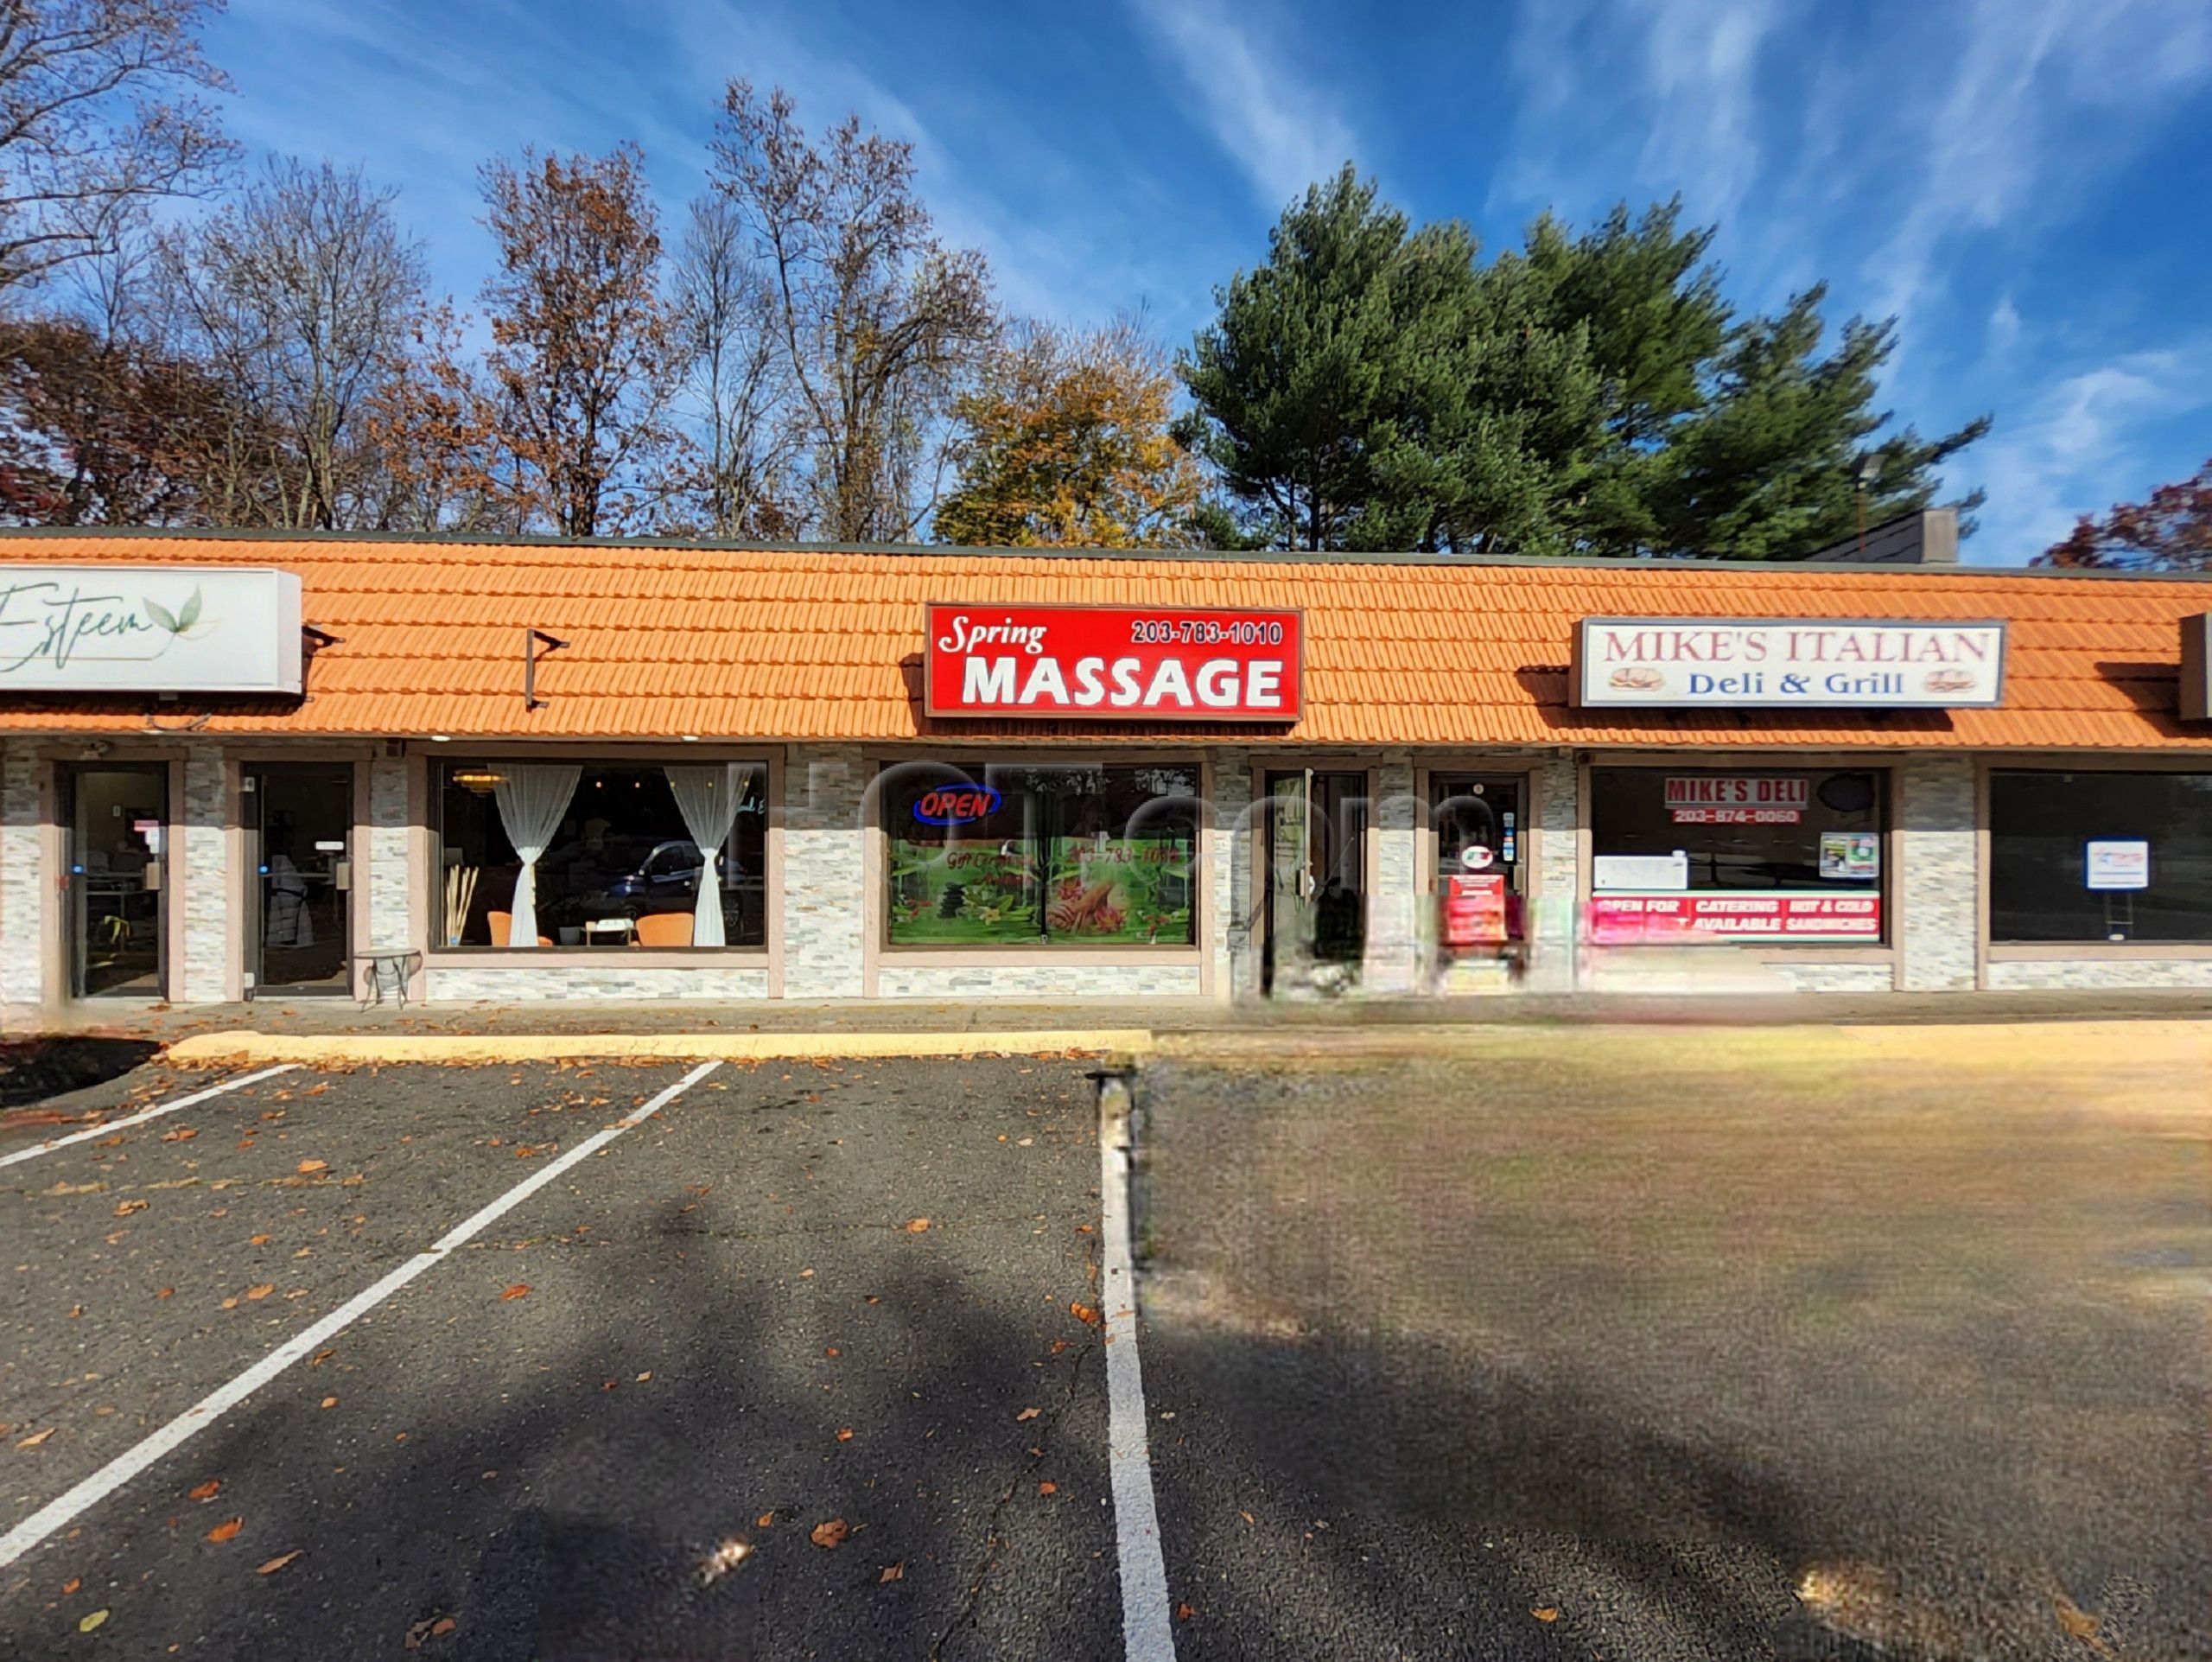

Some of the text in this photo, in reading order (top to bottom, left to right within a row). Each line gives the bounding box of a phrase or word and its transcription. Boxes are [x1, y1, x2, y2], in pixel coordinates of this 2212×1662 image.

[938, 615, 1047, 653] Spring
[1131, 621, 1283, 646] 203-783-1010
[1604, 631, 1989, 664] MIKE'S ITALIAN
[962, 656, 1284, 708] MASSAGE
[1688, 672, 1904, 695] Deli & Grill
[1667, 780, 1806, 802] MIKE'S DELI
[920, 793, 991, 817] OPEN
[1597, 900, 1681, 913] OPEN FOR
[1695, 901, 1780, 913] CATERING
[1789, 901, 1821, 913] HOT
[1692, 918, 1782, 931] AVAILABLE
